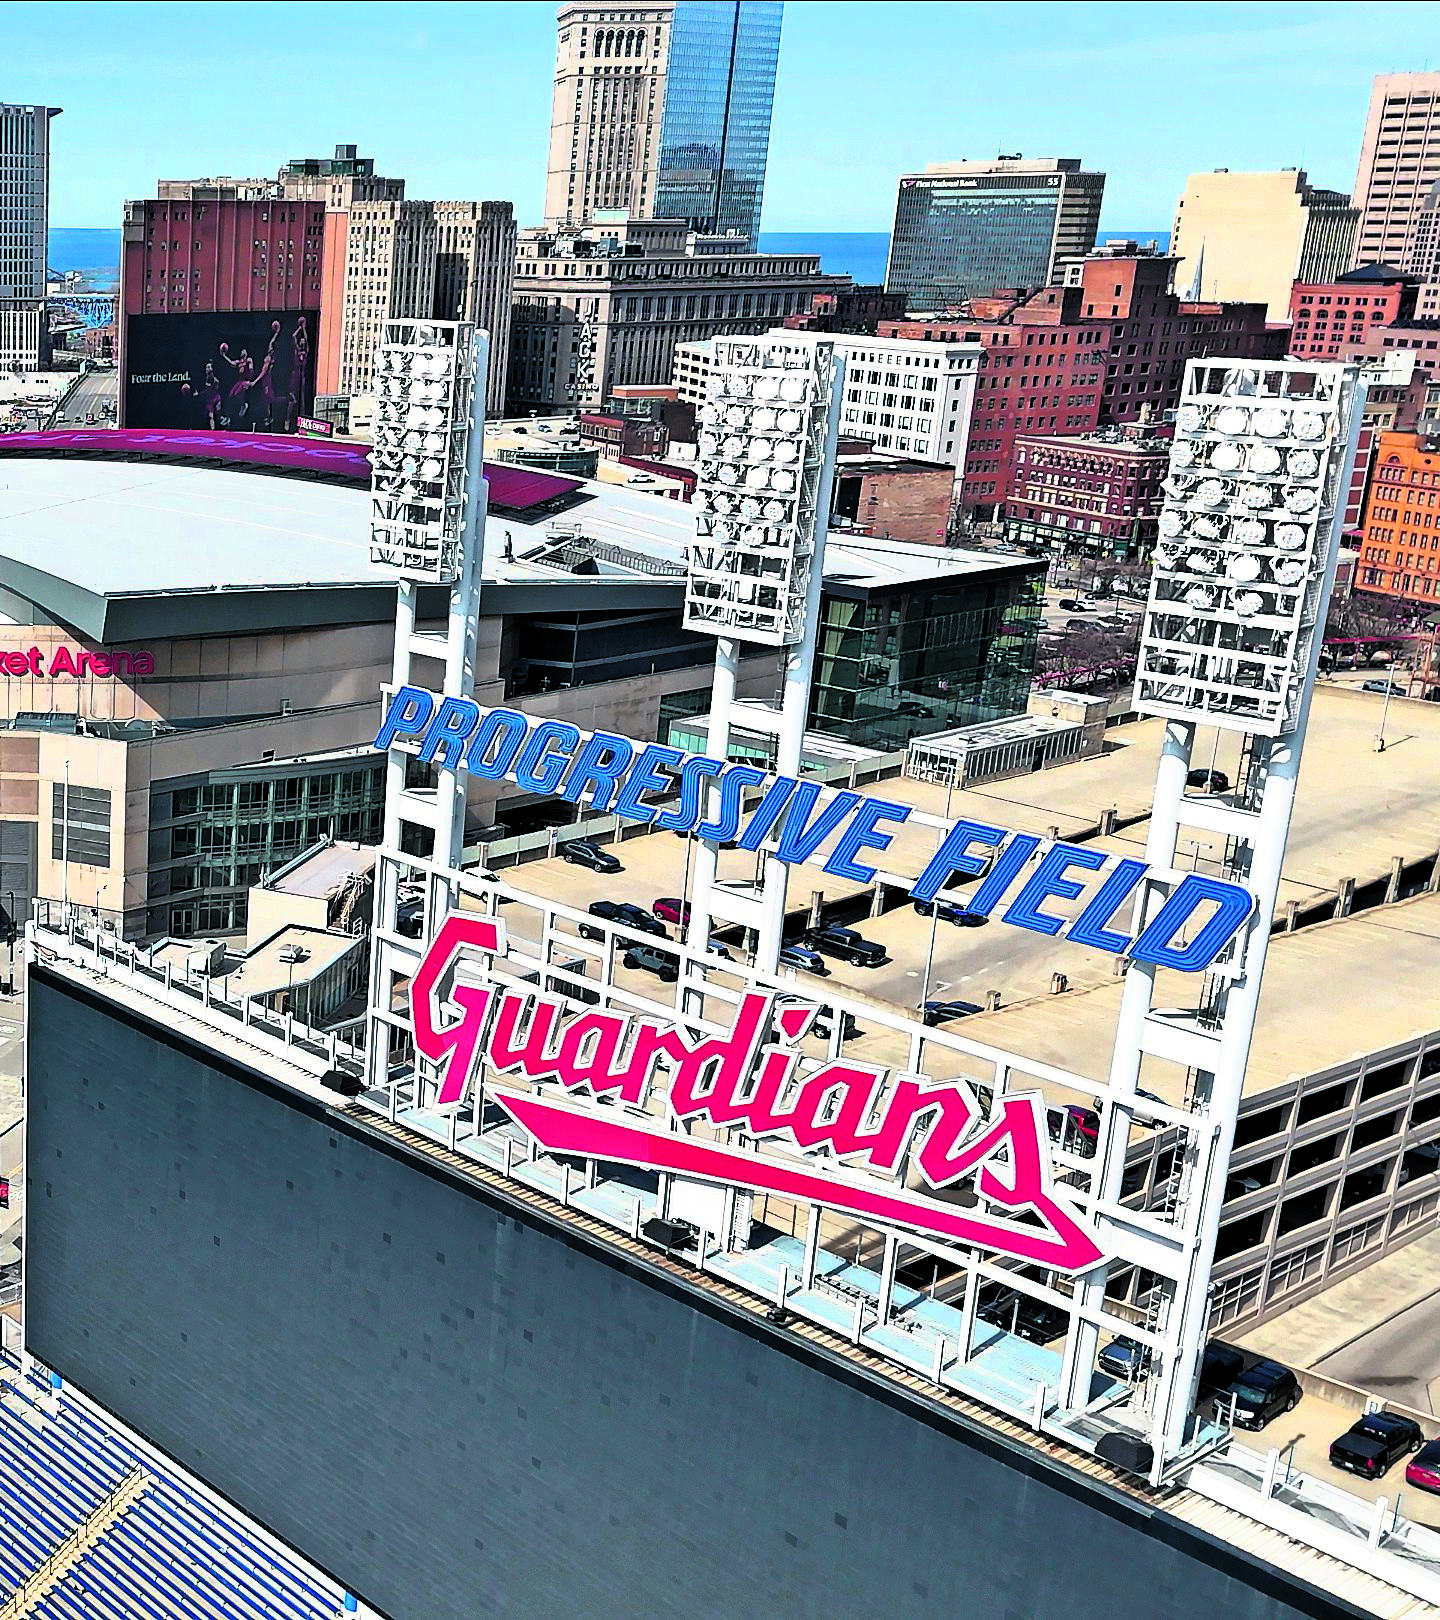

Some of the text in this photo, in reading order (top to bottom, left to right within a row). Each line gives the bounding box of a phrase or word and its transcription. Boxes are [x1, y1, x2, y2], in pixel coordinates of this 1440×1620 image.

[131, 374, 151, 383] Four
[152, 372, 166, 382] the
[564, 383, 599, 391] CASINO
[49, 646, 155, 678] Arena
[375, 684, 1255, 974] PROGRESSIVE FIELD
[408, 908, 1060, 1214] Guardians
